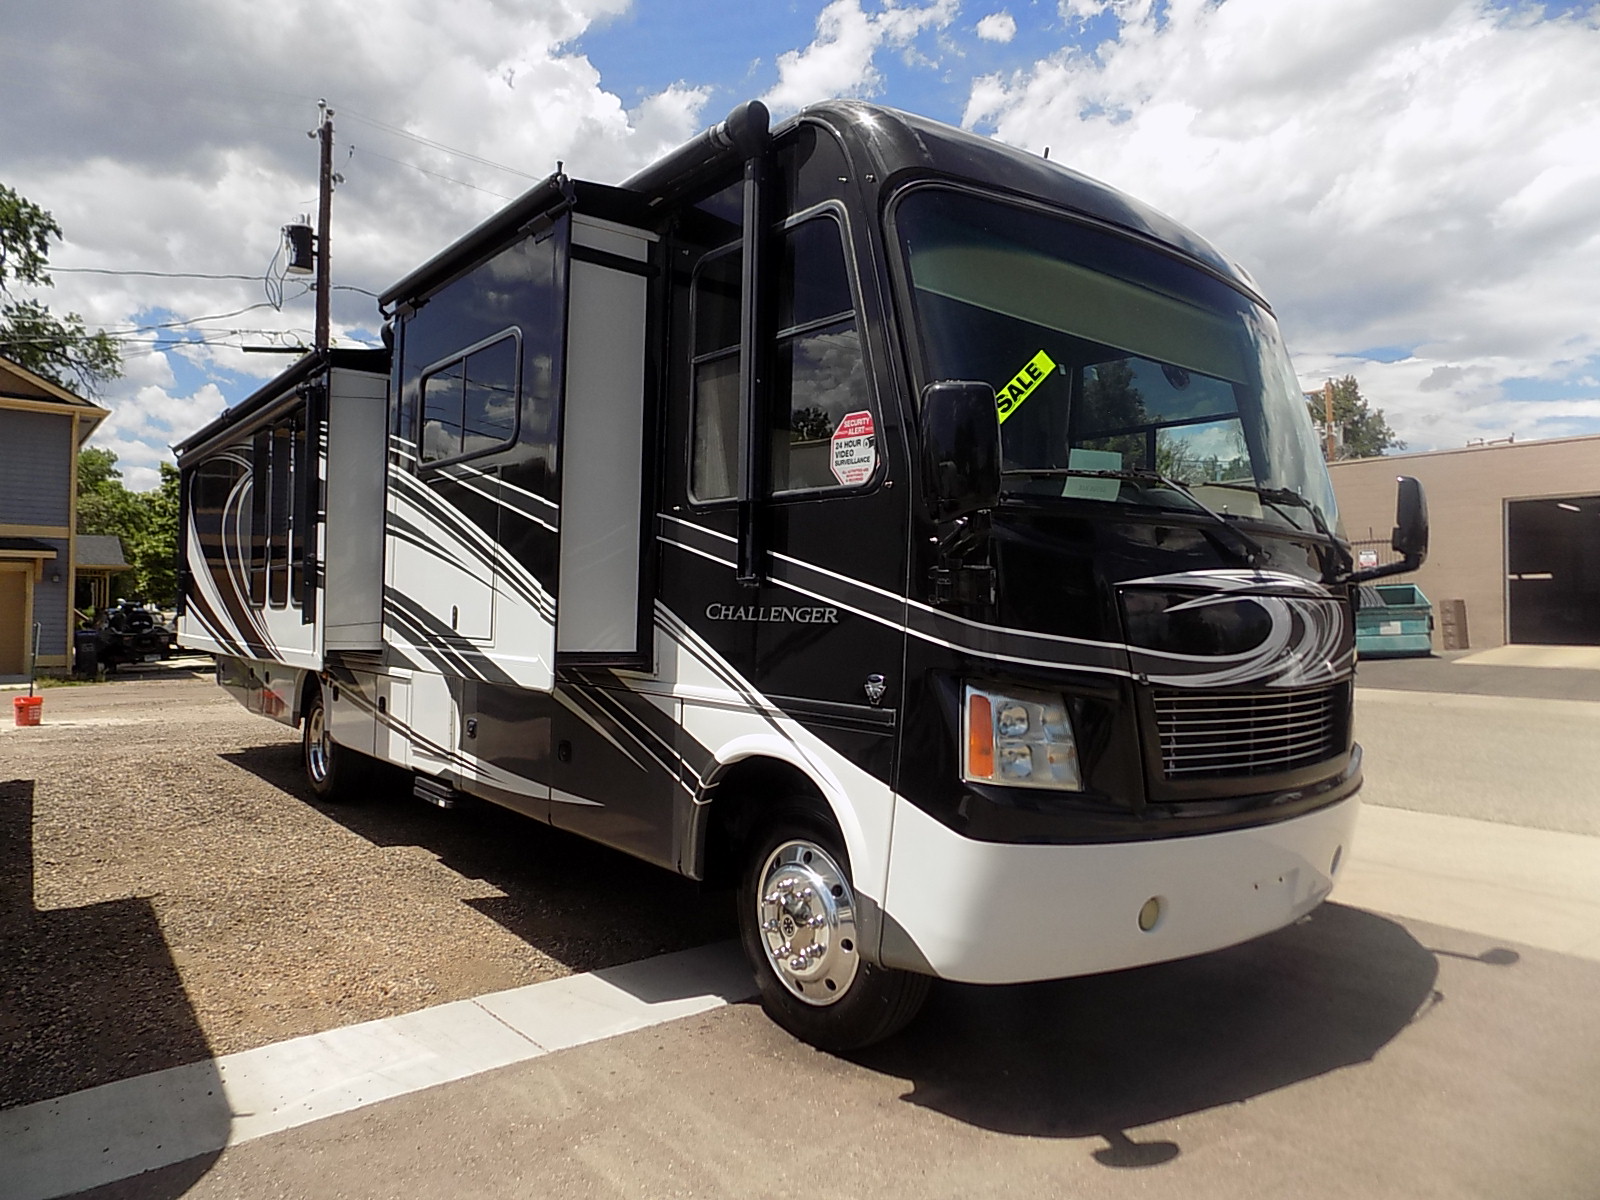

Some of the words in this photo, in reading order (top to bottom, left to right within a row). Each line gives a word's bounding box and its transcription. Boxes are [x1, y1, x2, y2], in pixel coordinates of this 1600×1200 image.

[997, 362, 1043, 413] SALE
[843, 417, 870, 428] SECURITY
[848, 426, 866, 435] ALERT
[835, 442, 843, 450] 24
[844, 439, 861, 448] HOUR
[835, 449, 854, 459] VIDEO
[834, 456, 871, 467] SURVEILLANCE
[705, 603, 839, 624] CHALLENGER
